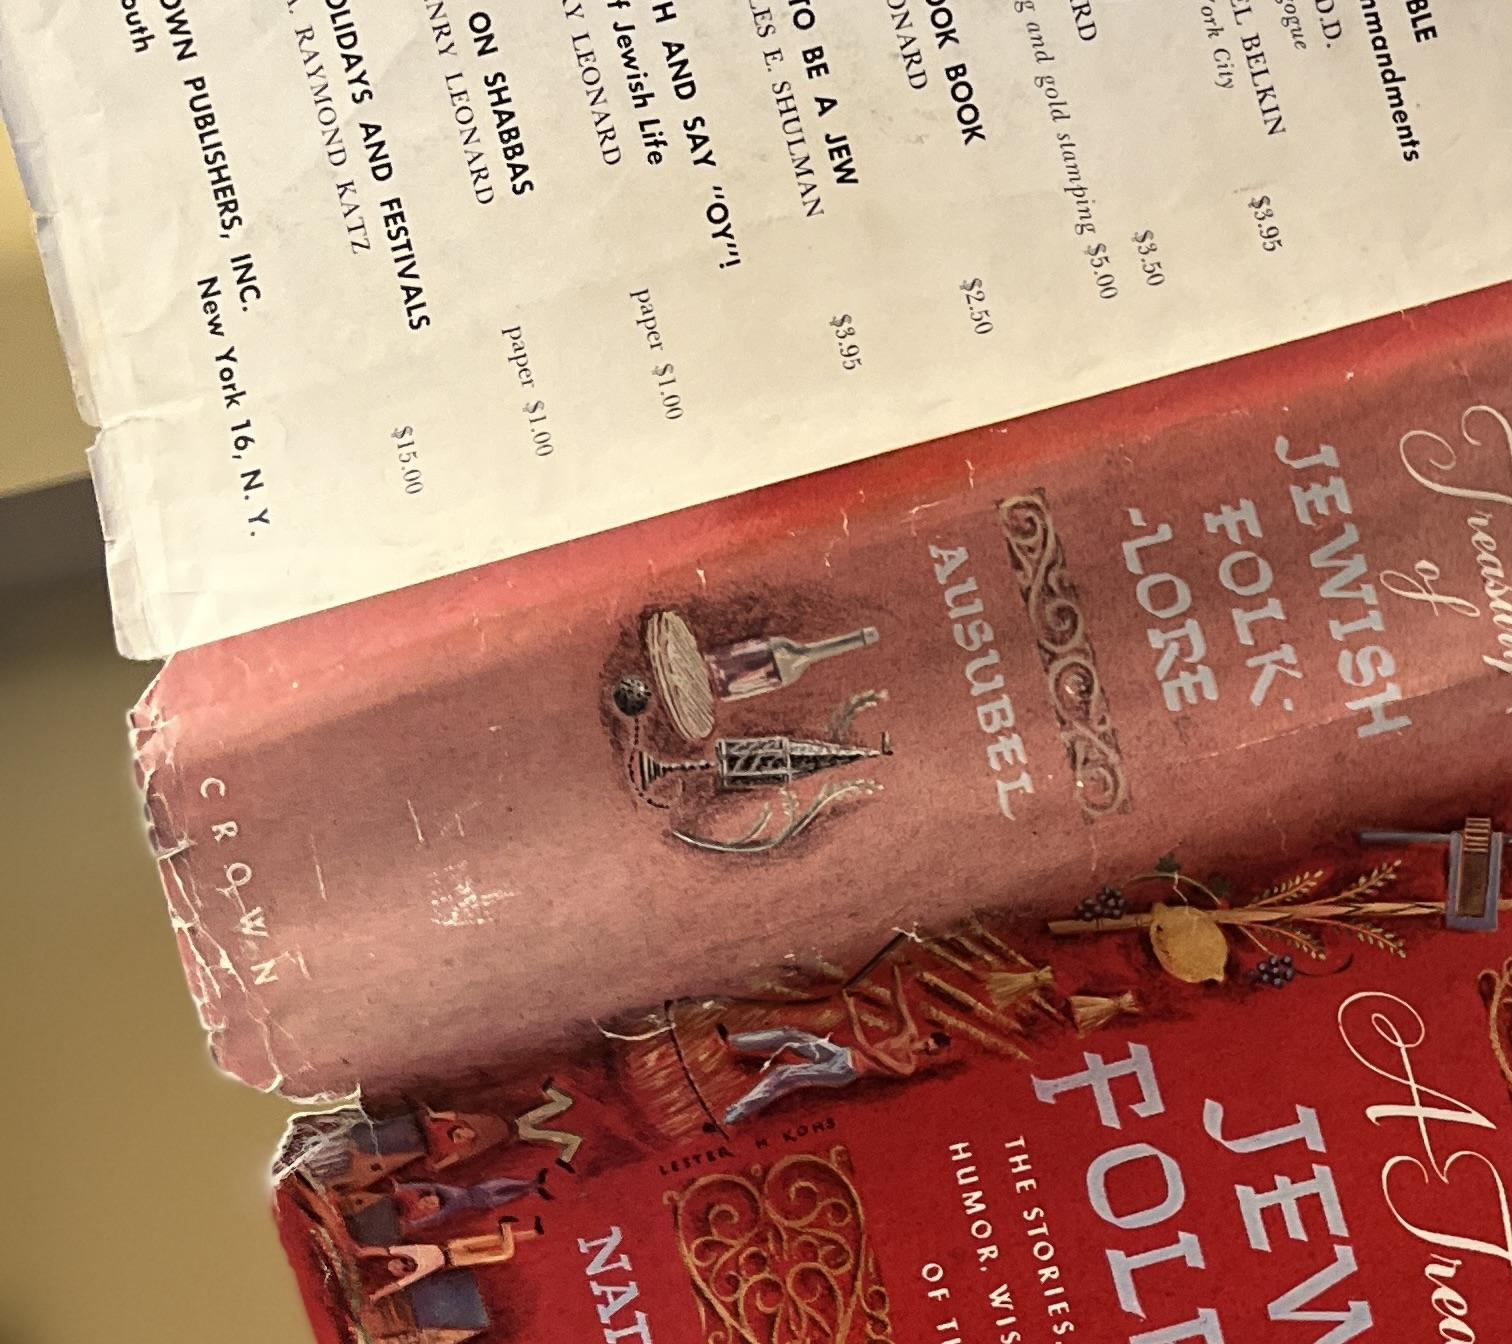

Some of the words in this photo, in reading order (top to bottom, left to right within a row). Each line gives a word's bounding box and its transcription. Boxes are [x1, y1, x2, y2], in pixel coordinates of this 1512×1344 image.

[801, 45, 829, 79] BE
[1212, 47, 1234, 88] City
[661, 40, 696, 100] AND
[682, 115, 716, 166] SAY
[813, 96, 838, 117] A
[944, 62, 986, 146] BOOK
[183, 75, 242, 238] PUBLISHERS,
[229, 252, 261, 312] INC.
[824, 132, 859, 184] JEW
[1133, 229, 1164, 286] $3.50
[1247, 194, 1283, 252] $3.95
[1202, 498, 1302, 711] FOLK-
[1274, 434, 1412, 737] JEWISH
[1379, 558, 1478, 616] of
[927, 544, 1034, 820] AUSUBEL
[200, 777, 278, 985] CROWN
[1337, 991, 1496, 1183] A
[1004, 1135, 1036, 1193] THE
[948, 1141, 998, 1271] HUMOR,
[921, 1262, 950, 1301] OF
